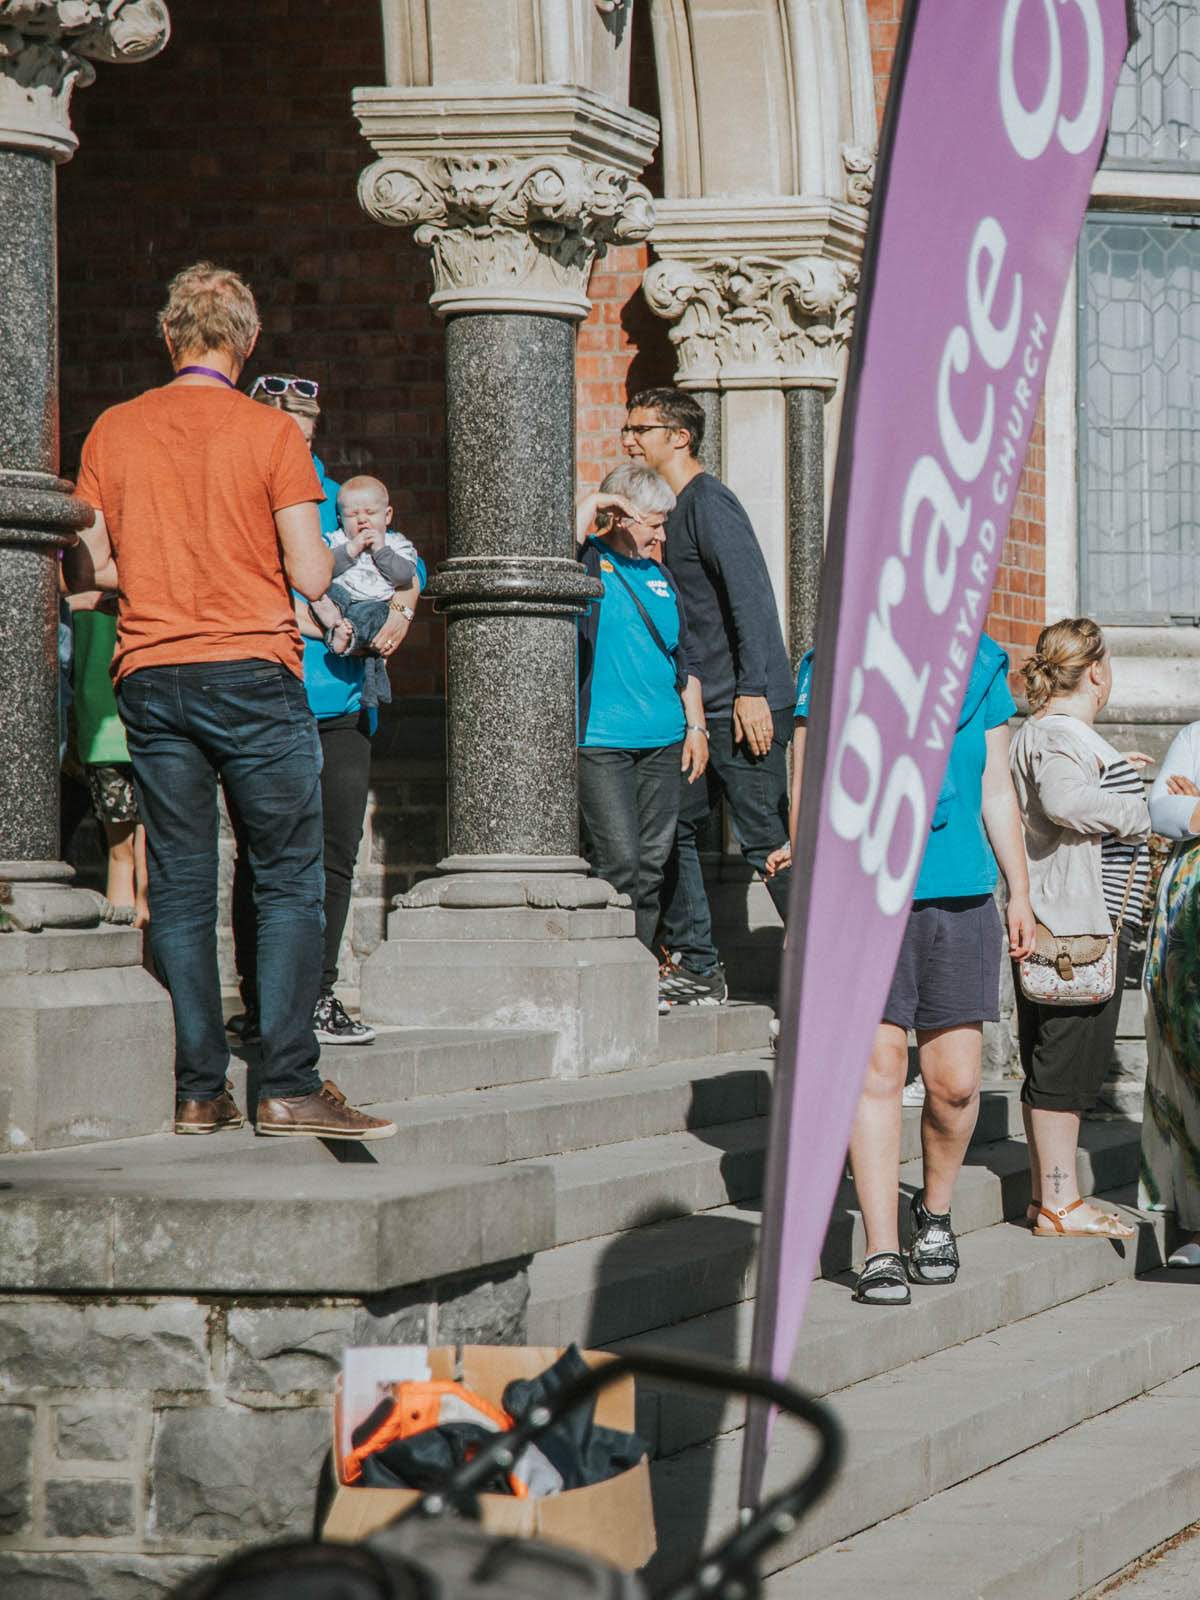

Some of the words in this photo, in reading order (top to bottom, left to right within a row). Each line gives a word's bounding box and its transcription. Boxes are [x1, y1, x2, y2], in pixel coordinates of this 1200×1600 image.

[829, 216, 1024, 917] grace
[925, 509, 997, 750] VINEYARD
[992, 311, 1047, 506] CHURCH
[866, 1259, 893, 1272] NIKE
[925, 1230, 951, 1242] NIKE
